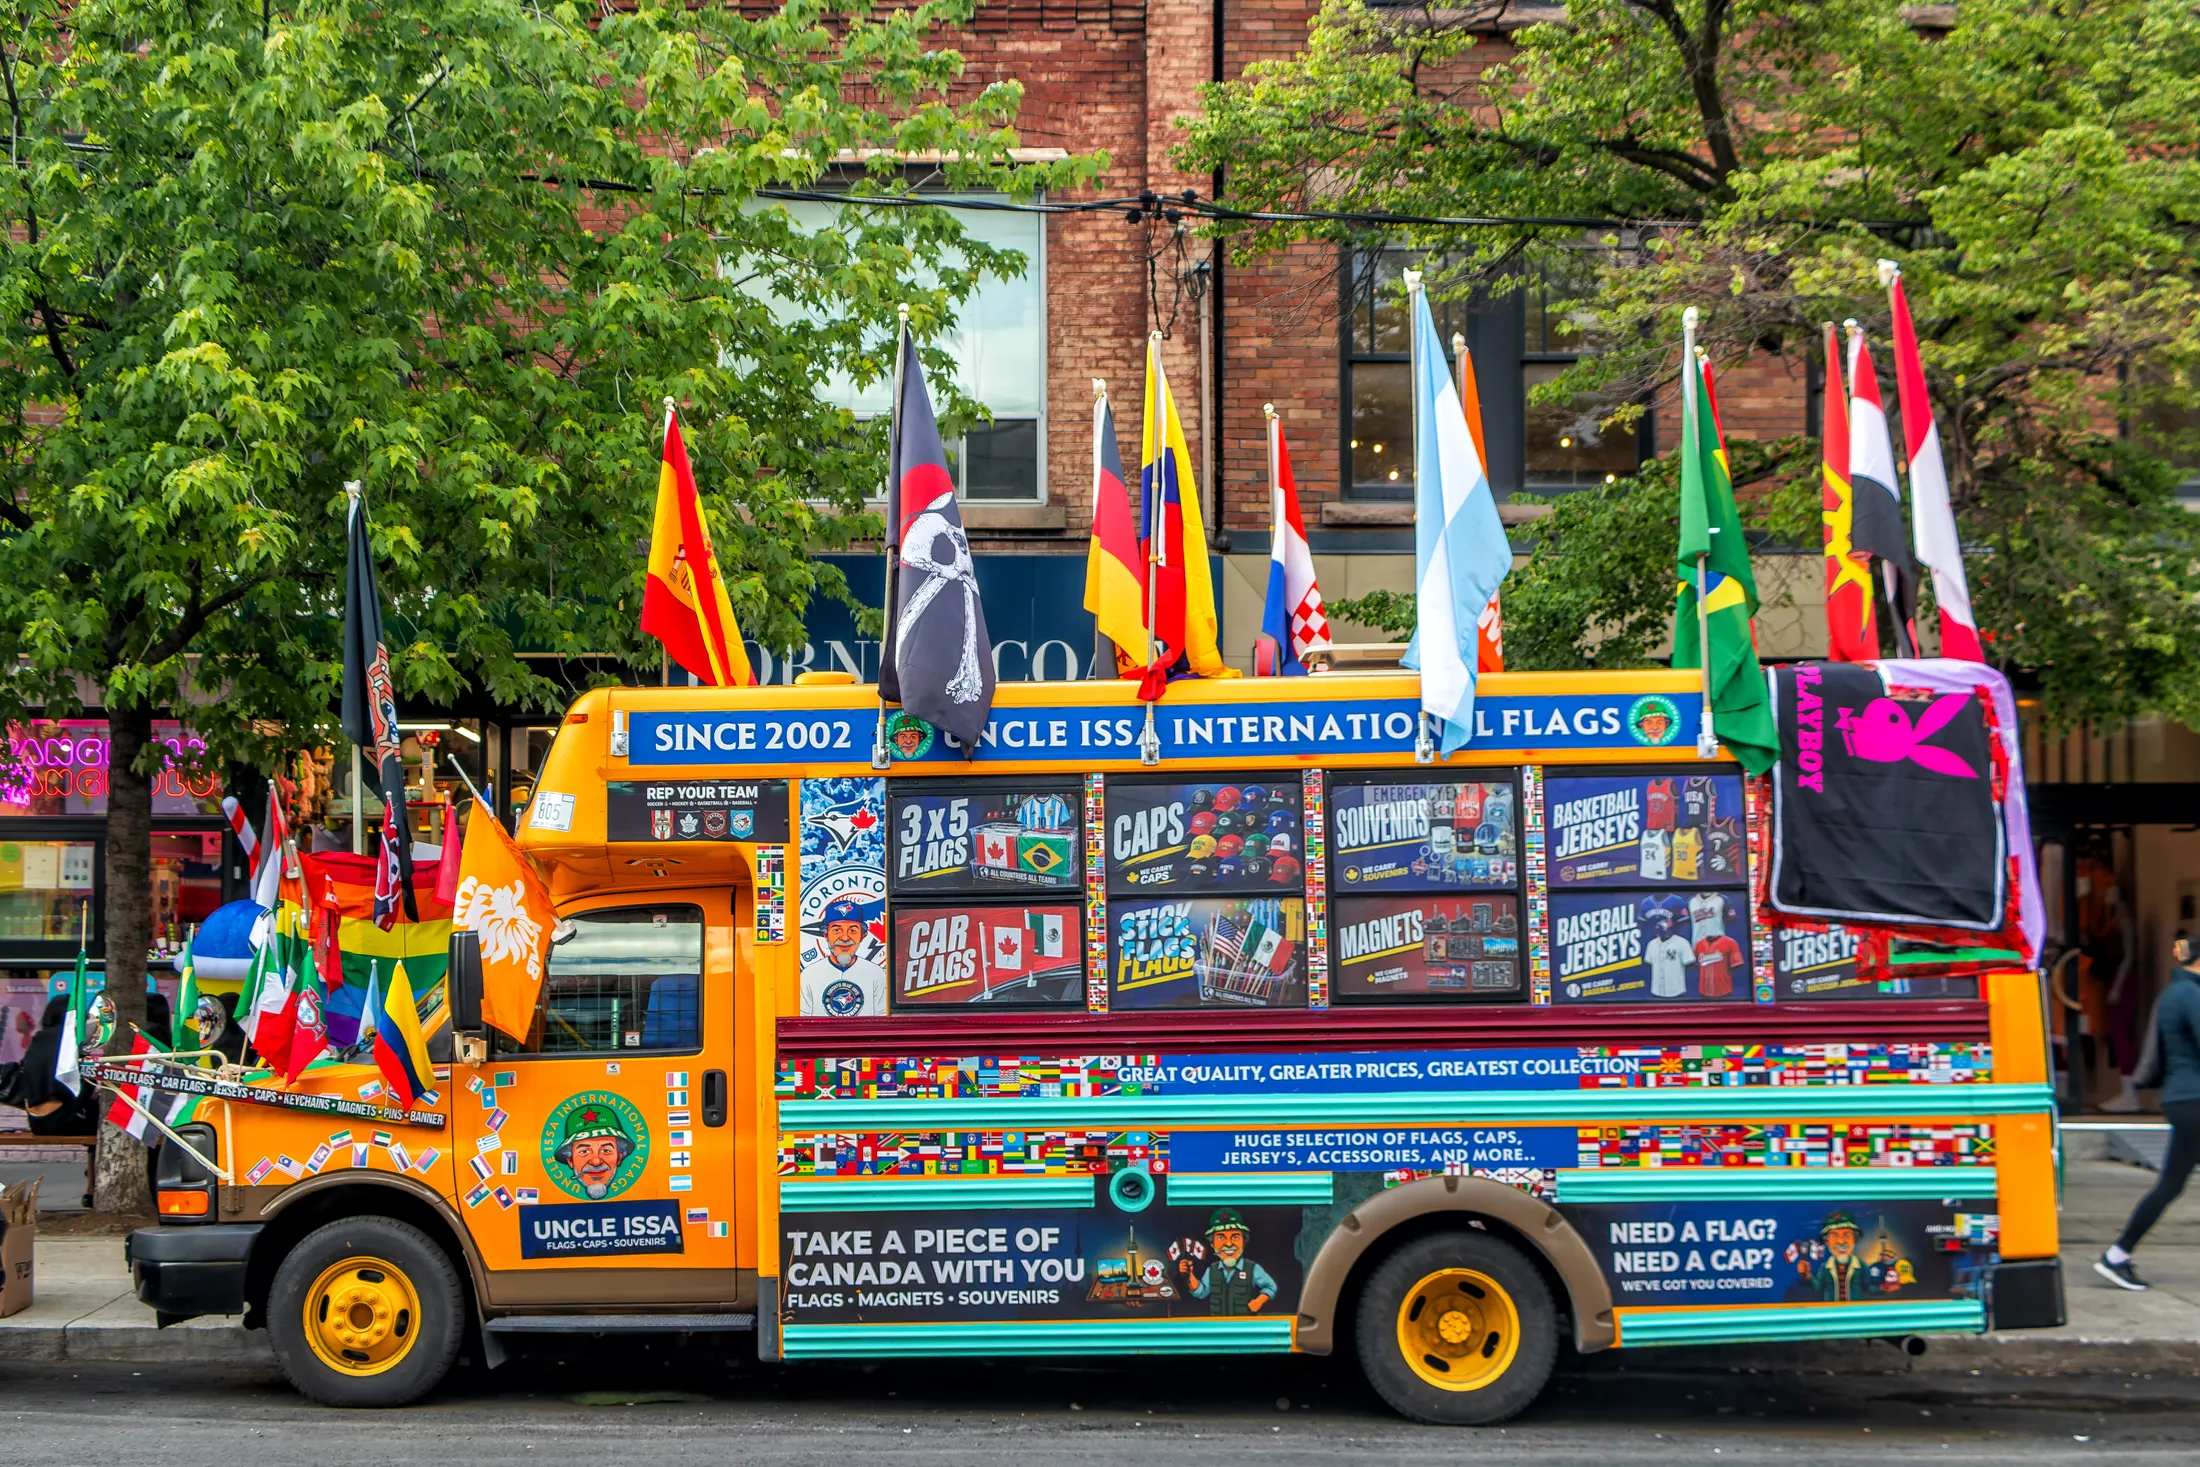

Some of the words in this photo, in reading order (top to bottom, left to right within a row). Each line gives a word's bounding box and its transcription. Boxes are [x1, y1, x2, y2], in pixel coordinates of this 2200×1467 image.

[654, 723, 759, 752] SINCE
[765, 721, 852, 750] 2002
[1173, 708, 1494, 745] INTERNATIOL
[1501, 707, 1621, 736] FLAGS
[646, 787, 674, 799] REP
[677, 787, 716, 799] YOUR
[718, 786, 758, 798] TEAM
[1373, 786, 1443, 801] EMERGENCY
[1446, 785, 1469, 800] EXT
[538, 802, 561, 821] 805
[900, 804, 922, 846] 3
[949, 798, 969, 837] 5
[1336, 798, 1430, 848] SOUVENIRS
[1553, 788, 1639, 829] BASKETBALL
[1113, 802, 1184, 860] CAPS
[1555, 811, 1640, 857] JERSEYS
[899, 837, 968, 878] FLAGS
[1151, 864, 1173, 873] CARRY
[990, 869, 1000, 877] ALL
[1000, 870, 1027, 881] COUNTRIES
[1038, 875, 1057, 885] TEAMS
[1140, 872, 1169, 884] CAPS
[1363, 867, 1409, 881] SOUVENIRS
[802, 875, 885, 918] TORONTO
[908, 914, 970, 959] CAR
[1121, 916, 1191, 941] STICK
[1340, 909, 1425, 959] MAGNETS
[1556, 903, 1638, 947] BASEBALL
[1122, 937, 1196, 962] FLAGS
[1560, 928, 1641, 975] JERSEYS
[904, 948, 976, 991] FLAGS
[1118, 1066, 1178, 1082] GREAT
[1181, 1065, 1266, 1084] QUALITY,
[1269, 1063, 1354, 1080] GREATER
[1356, 1062, 1424, 1080] PRICES,
[1427, 1060, 1520, 1077] GREATEST
[1522, 1058, 1640, 1075] COLLECTION
[103, 1070, 128, 1083] STICK
[128, 1073, 155, 1087] FLAGS
[161, 1076, 179, 1090] CAR
[179, 1079, 206, 1093] FLAGS
[212, 1084, 248, 1099] JERSEYS
[254, 1089, 276, 1102] CAPS
[283, 1093, 331, 1110] KEYCHAINS
[336, 1100, 377, 1117] MAGNETS
[383, 1107, 403, 1120] PINS
[410, 1111, 444, 1125] BANNER
[556, 1093, 647, 1150] INTERNATIONAL
[544, 1122, 560, 1151] ISSA
[1234, 1134, 1282, 1148] HUGE
[1286, 1132, 1378, 1147] SELECTION
[1383, 1132, 1406, 1145] OF
[1411, 1131, 1469, 1146] FLAGS,
[1473, 1130, 1523, 1146] CAPS,
[1221, 1151, 1301, 1166] JERSEY'S,
[1306, 1149, 1426, 1164] ACCESSORIES,
[1430, 1149, 1468, 1162] AND
[546, 1156, 581, 1194] UNCLE
[611, 1155, 645, 1192] FLAGS
[534, 1218, 616, 1240] UNCLE
[623, 1215, 679, 1236] ISSA
[787, 1230, 872, 1256] TAKE
[880, 1230, 906, 1255] A
[914, 1228, 1008, 1254] PIECE
[1015, 1227, 1060, 1253] OF
[1610, 1221, 1675, 1244] NEED
[1680, 1220, 1700, 1243] A
[1705, 1219, 1777, 1242] FLAG?
[547, 1240, 576, 1250] FLAGS
[582, 1240, 607, 1249] CAPS
[614, 1237, 667, 1248] SOUVENIRS
[788, 1260, 926, 1287] CANADA
[932, 1259, 1014, 1285] WITH
[1020, 1258, 1085, 1283] YOU
[1613, 1250, 1680, 1274] NEED
[1684, 1250, 1706, 1272] A
[1709, 1248, 1774, 1272] CAP?
[787, 1293, 844, 1308] FLAGS
[858, 1291, 944, 1307] MAGNETS
[958, 1289, 1060, 1305] SOUVENIRS
[1621, 1279, 1661, 1292] WE'VE
[1662, 1278, 1688, 1291] GOT
[1688, 1278, 1715, 1290] YOU
[1716, 1277, 1774, 1289] COVERED
